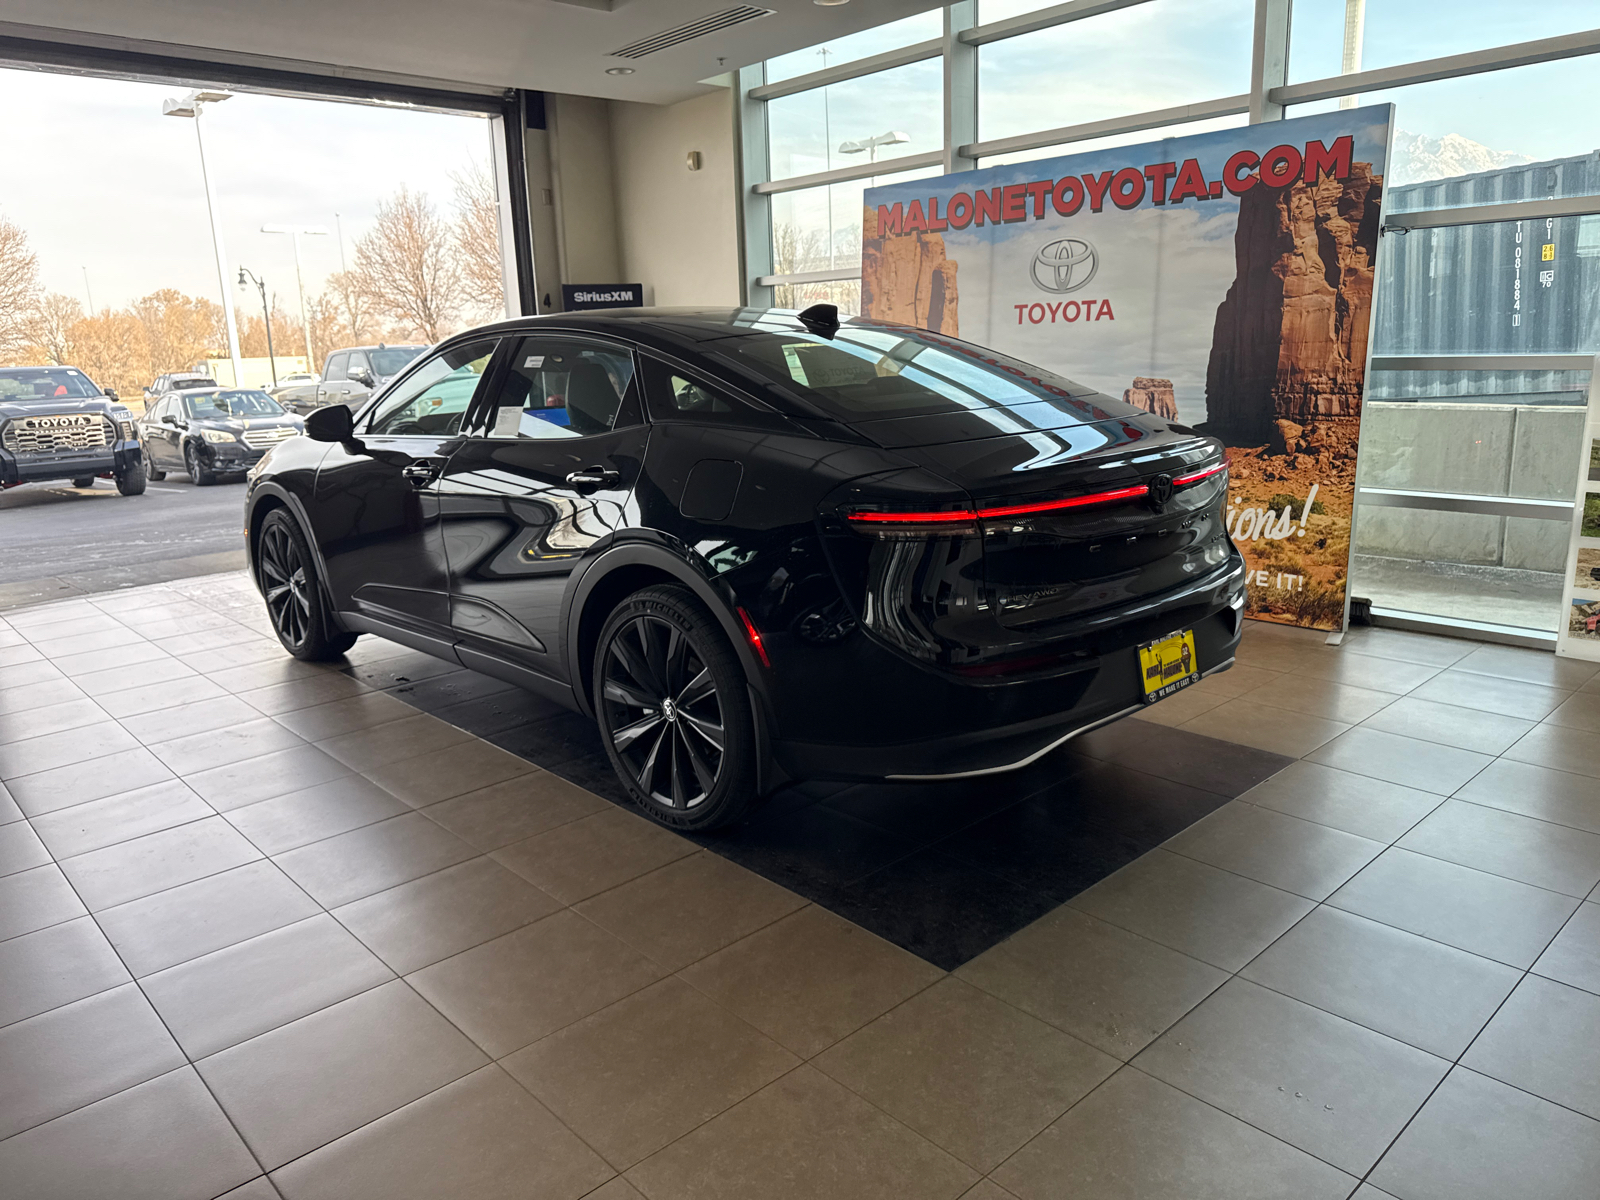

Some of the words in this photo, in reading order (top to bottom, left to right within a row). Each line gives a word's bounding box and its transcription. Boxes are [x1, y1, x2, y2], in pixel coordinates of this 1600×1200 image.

[877, 135, 1354, 238] MALONETOYOTA.COM
[573, 291, 634, 303] SiriusXM
[1014, 298, 1115, 325] TOYOTA
[32, 417, 86, 428] TOYOTA
[1277, 573, 1303, 592] IT!
[645, 601, 692, 630] MICHELIN
[1182, 647, 1189, 656] 32
